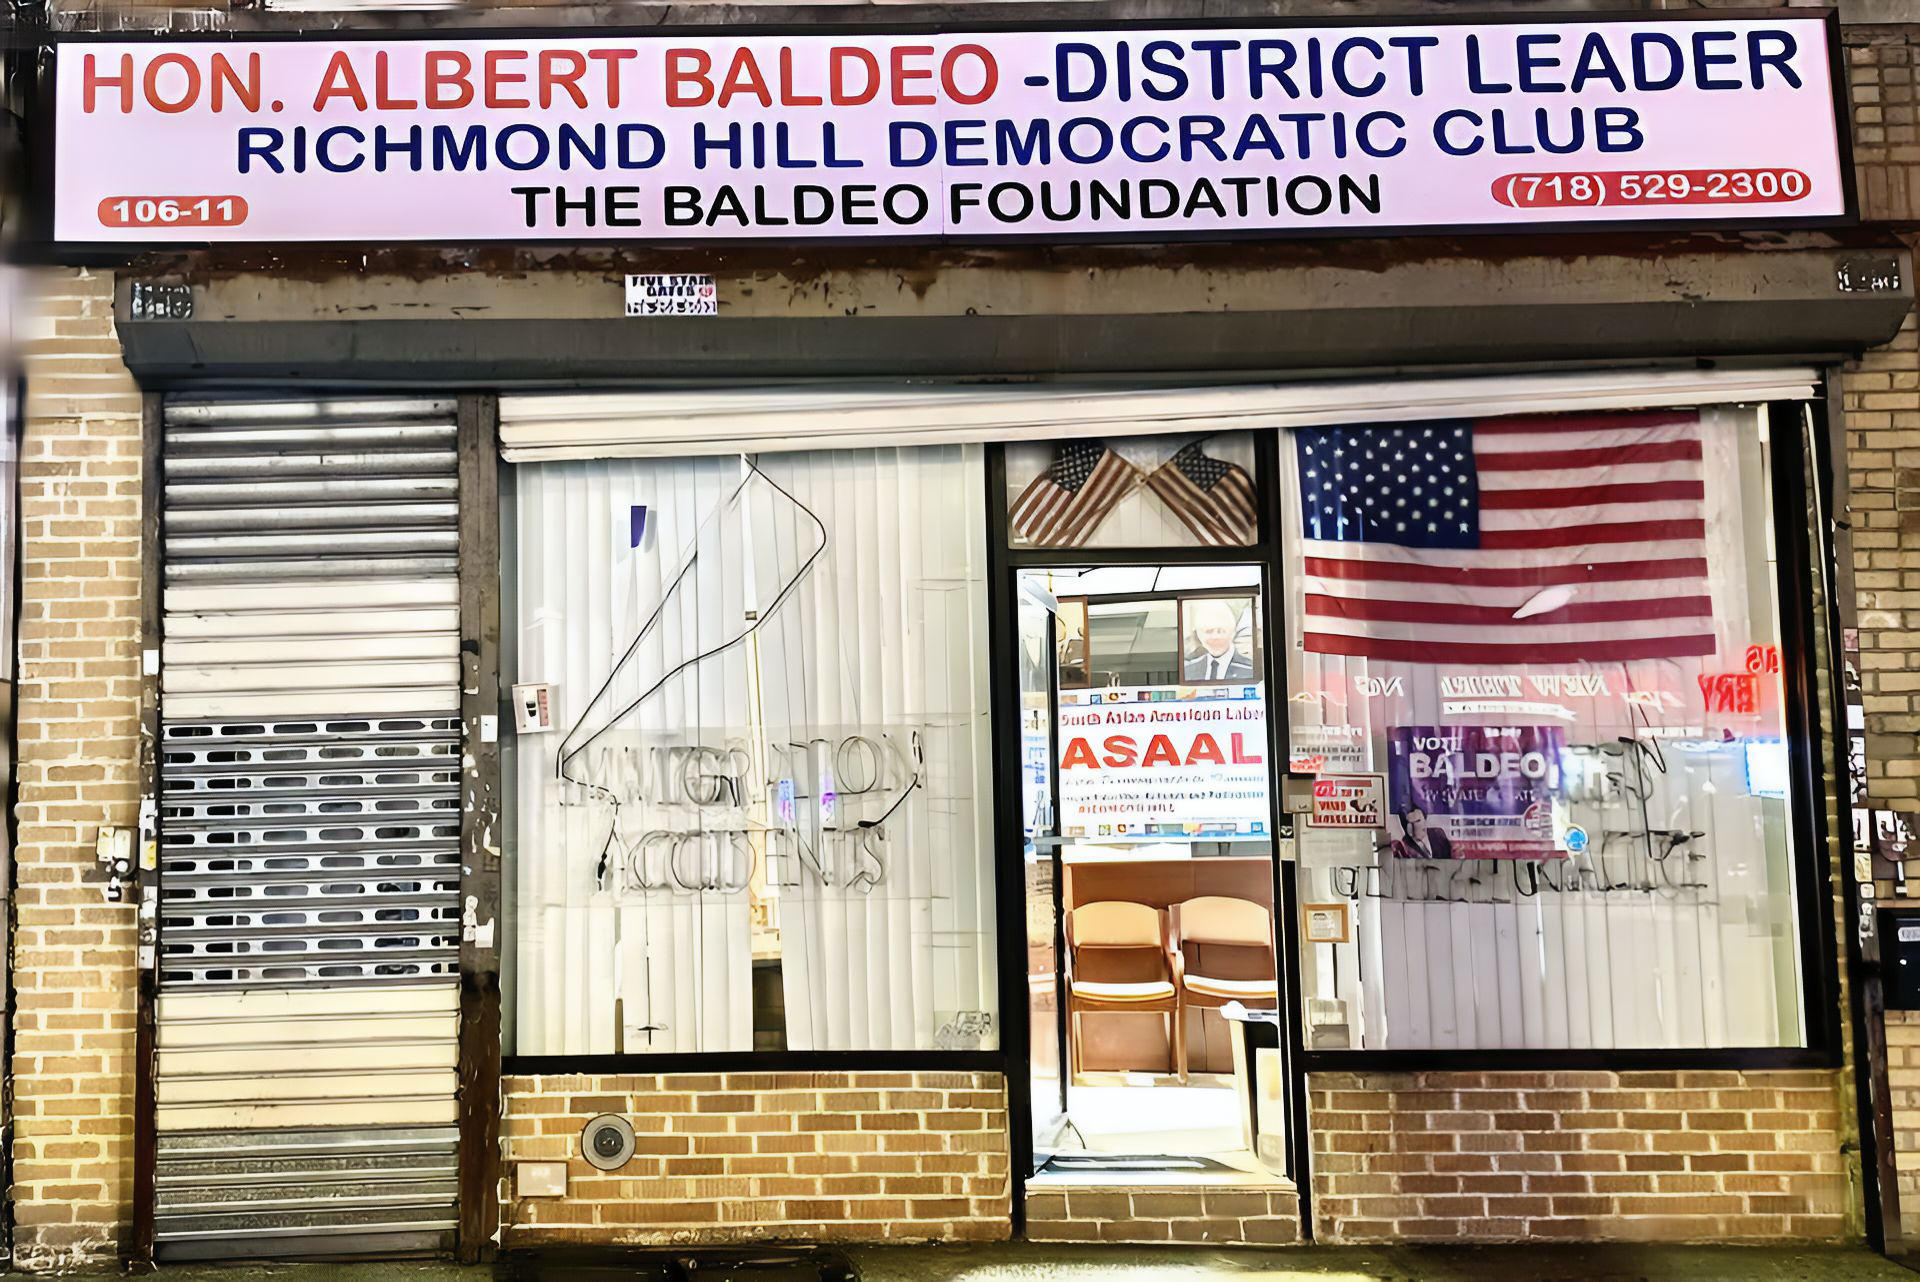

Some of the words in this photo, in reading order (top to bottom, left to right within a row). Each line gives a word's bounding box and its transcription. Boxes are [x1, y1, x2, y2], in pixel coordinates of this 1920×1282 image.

[84, 51, 284, 114] HON.
[312, 48, 638, 113] ALBERT
[665, 43, 999, 108] BALDEO
[1465, 29, 1803, 95] LEADER
[237, 121, 666, 174] RICHMOND
[693, 121, 864, 170] HILL
[888, 110, 1407, 168] DEMOCRATIC
[1432, 106, 1644, 157] CLUB
[510, 185, 642, 228] THE
[663, 183, 929, 227] BALDEO
[950, 173, 1381, 225] FOUNDATION
[1507, 174, 1606, 208] (718)
[1620, 171, 1804, 199] 529-2300
[112, 199, 235, 223] 106-11
[1060, 732, 1262, 769] ASAAL
[1409, 751, 1546, 779] BALDEO
